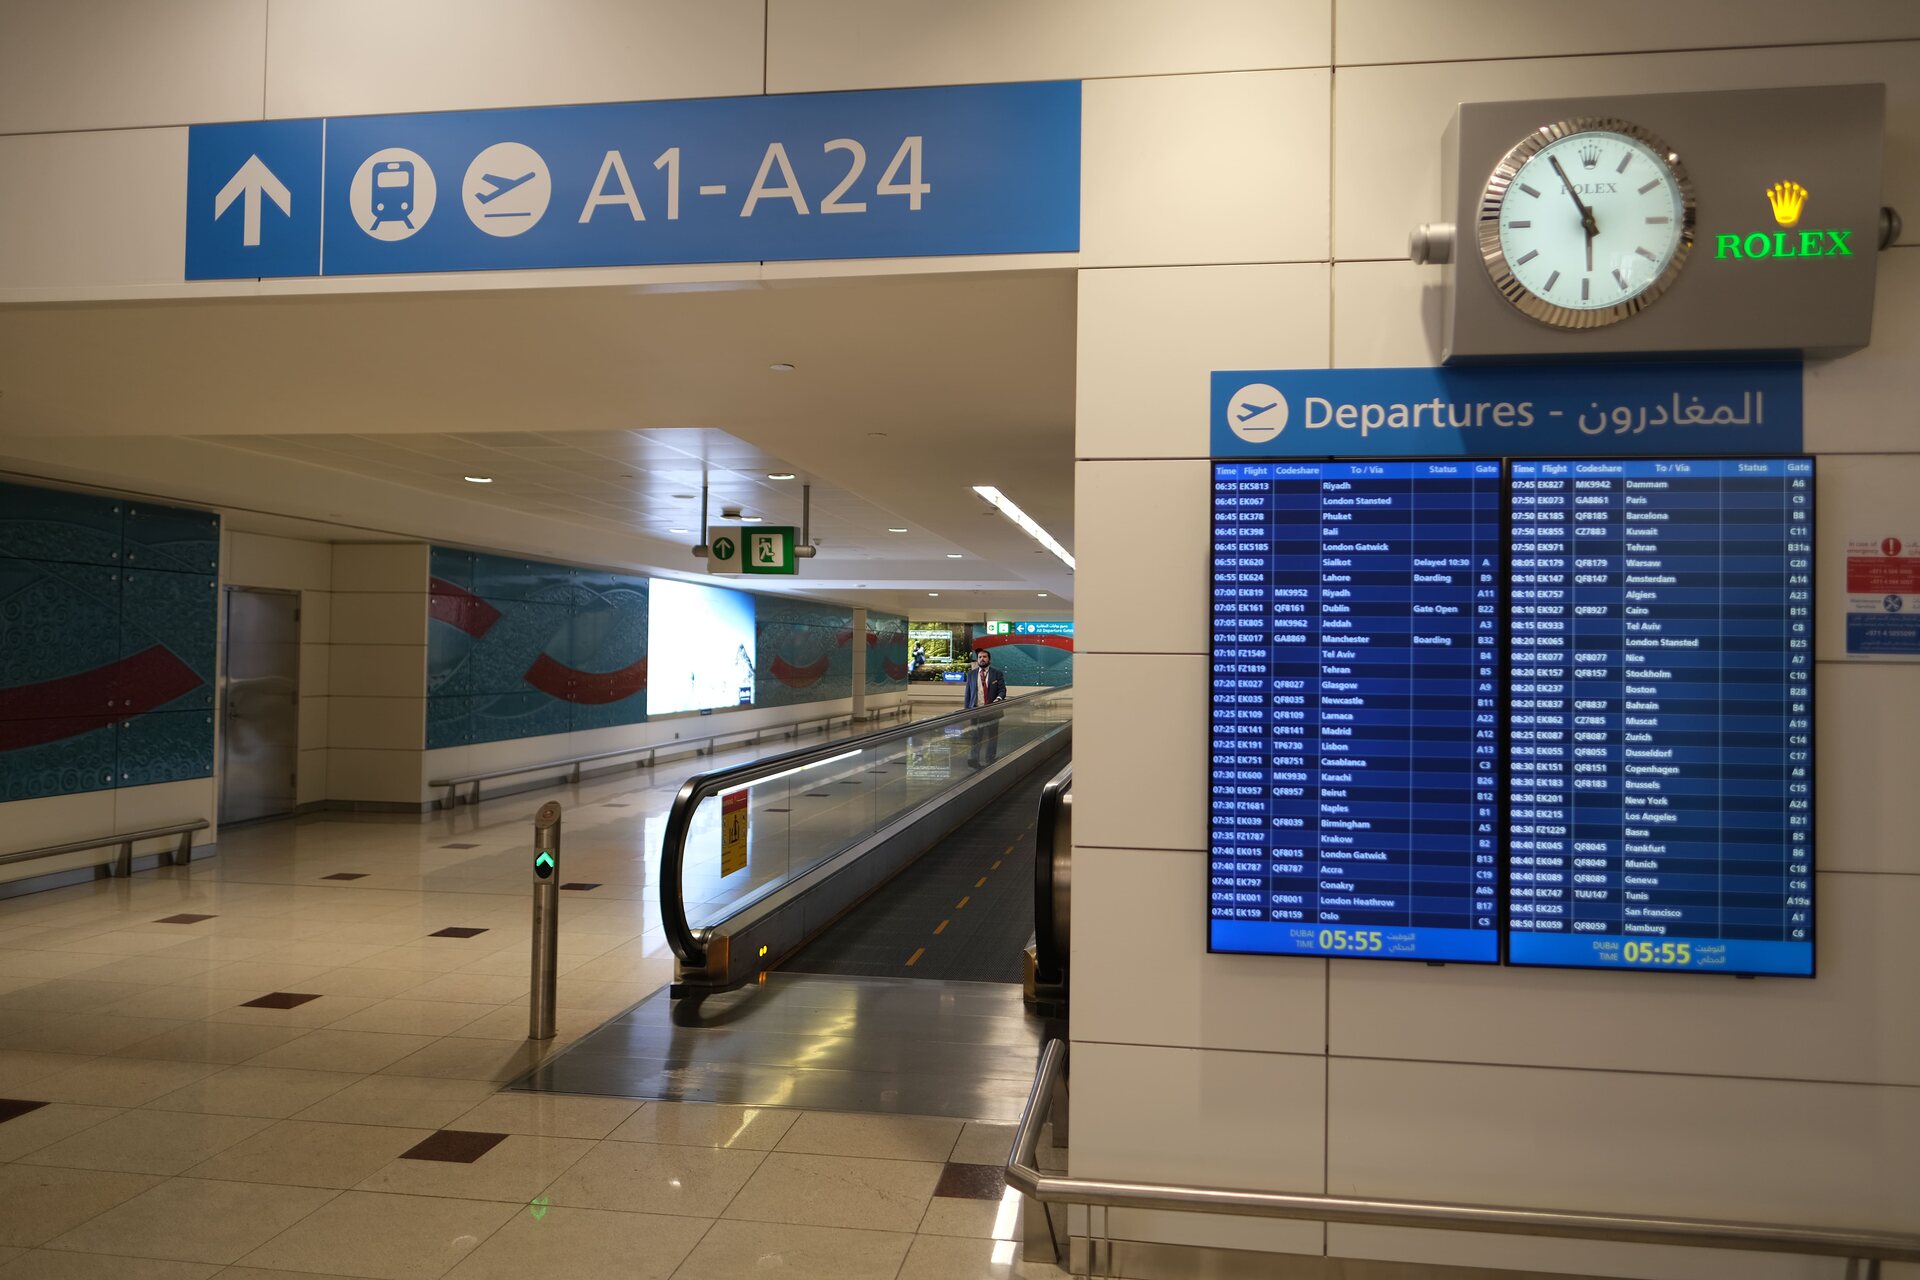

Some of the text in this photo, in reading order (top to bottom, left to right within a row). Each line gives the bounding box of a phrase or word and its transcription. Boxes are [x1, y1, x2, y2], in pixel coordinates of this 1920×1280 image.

[578, 135, 932, 225] A1-A24
[1714, 230, 1854, 260] ROLEX
[1304, 395, 1534, 437] Departures
[1578, 391, 1764, 435] المغادرون
[1244, 466, 1267, 476] Flight
[1276, 466, 1319, 474] Codeshare
[1542, 464, 1568, 474] Flight
[1576, 464, 1622, 472] Codeshare
[1655, 464, 1666, 472] To
[1675, 464, 1690, 472] Via
[1738, 464, 1768, 472] Status
[1787, 463, 1810, 471] Gate
[1414, 558, 1447, 567] Delayed
[1414, 574, 1452, 584] Boarding
[1626, 575, 1676, 583] Amsterdam
[1435, 605, 1458, 614] Open
[1322, 635, 1370, 643] Manchester
[1413, 636, 1451, 646] Boarding
[1625, 670, 1672, 678] Stockholm
[1214, 680, 1236, 688] 07:20
[1238, 680, 1263, 688] EK027
[1321, 681, 1358, 691] Glasgow
[1213, 725, 1235, 733] 07:25
[1322, 727, 1352, 736] Madrid
[1476, 730, 1494, 738] A12
[1213, 756, 1235, 764] 07:25
[1237, 756, 1262, 764] EK751
[1321, 758, 1366, 766] Casablanca
[1625, 764, 1679, 775] Copenhagen
[1510, 810, 1534, 818] 08:30
[1625, 812, 1641, 820] Los
[1642, 812, 1677, 823] Angeles
[1212, 816, 1235, 824] 07:35
[1237, 817, 1262, 825] EK039
[1321, 819, 1371, 830] Birmingham
[1510, 841, 1534, 849] 08:40
[1625, 844, 1666, 853] Frankfurt
[1212, 847, 1234, 855] 07:40
[1236, 848, 1262, 856] EK015
[1321, 850, 1352, 859] London
[1353, 851, 1387, 860] Gatwick
[1477, 855, 1493, 863] B13
[1212, 892, 1234, 901] 07:45
[1236, 893, 1261, 902] EK001
[1320, 896, 1352, 905] London
[1353, 898, 1394, 906] Heathrow
[1510, 904, 1534, 912] 08:45
[1625, 907, 1642, 916] San
[1643, 908, 1682, 917] Francisco
[1290, 929, 1382, 951] DUBAI 05:55
[1296, 940, 1314, 948] TIME
[1593, 941, 1691, 964] DUBAI 05:55
[1600, 952, 1618, 960] TIME
